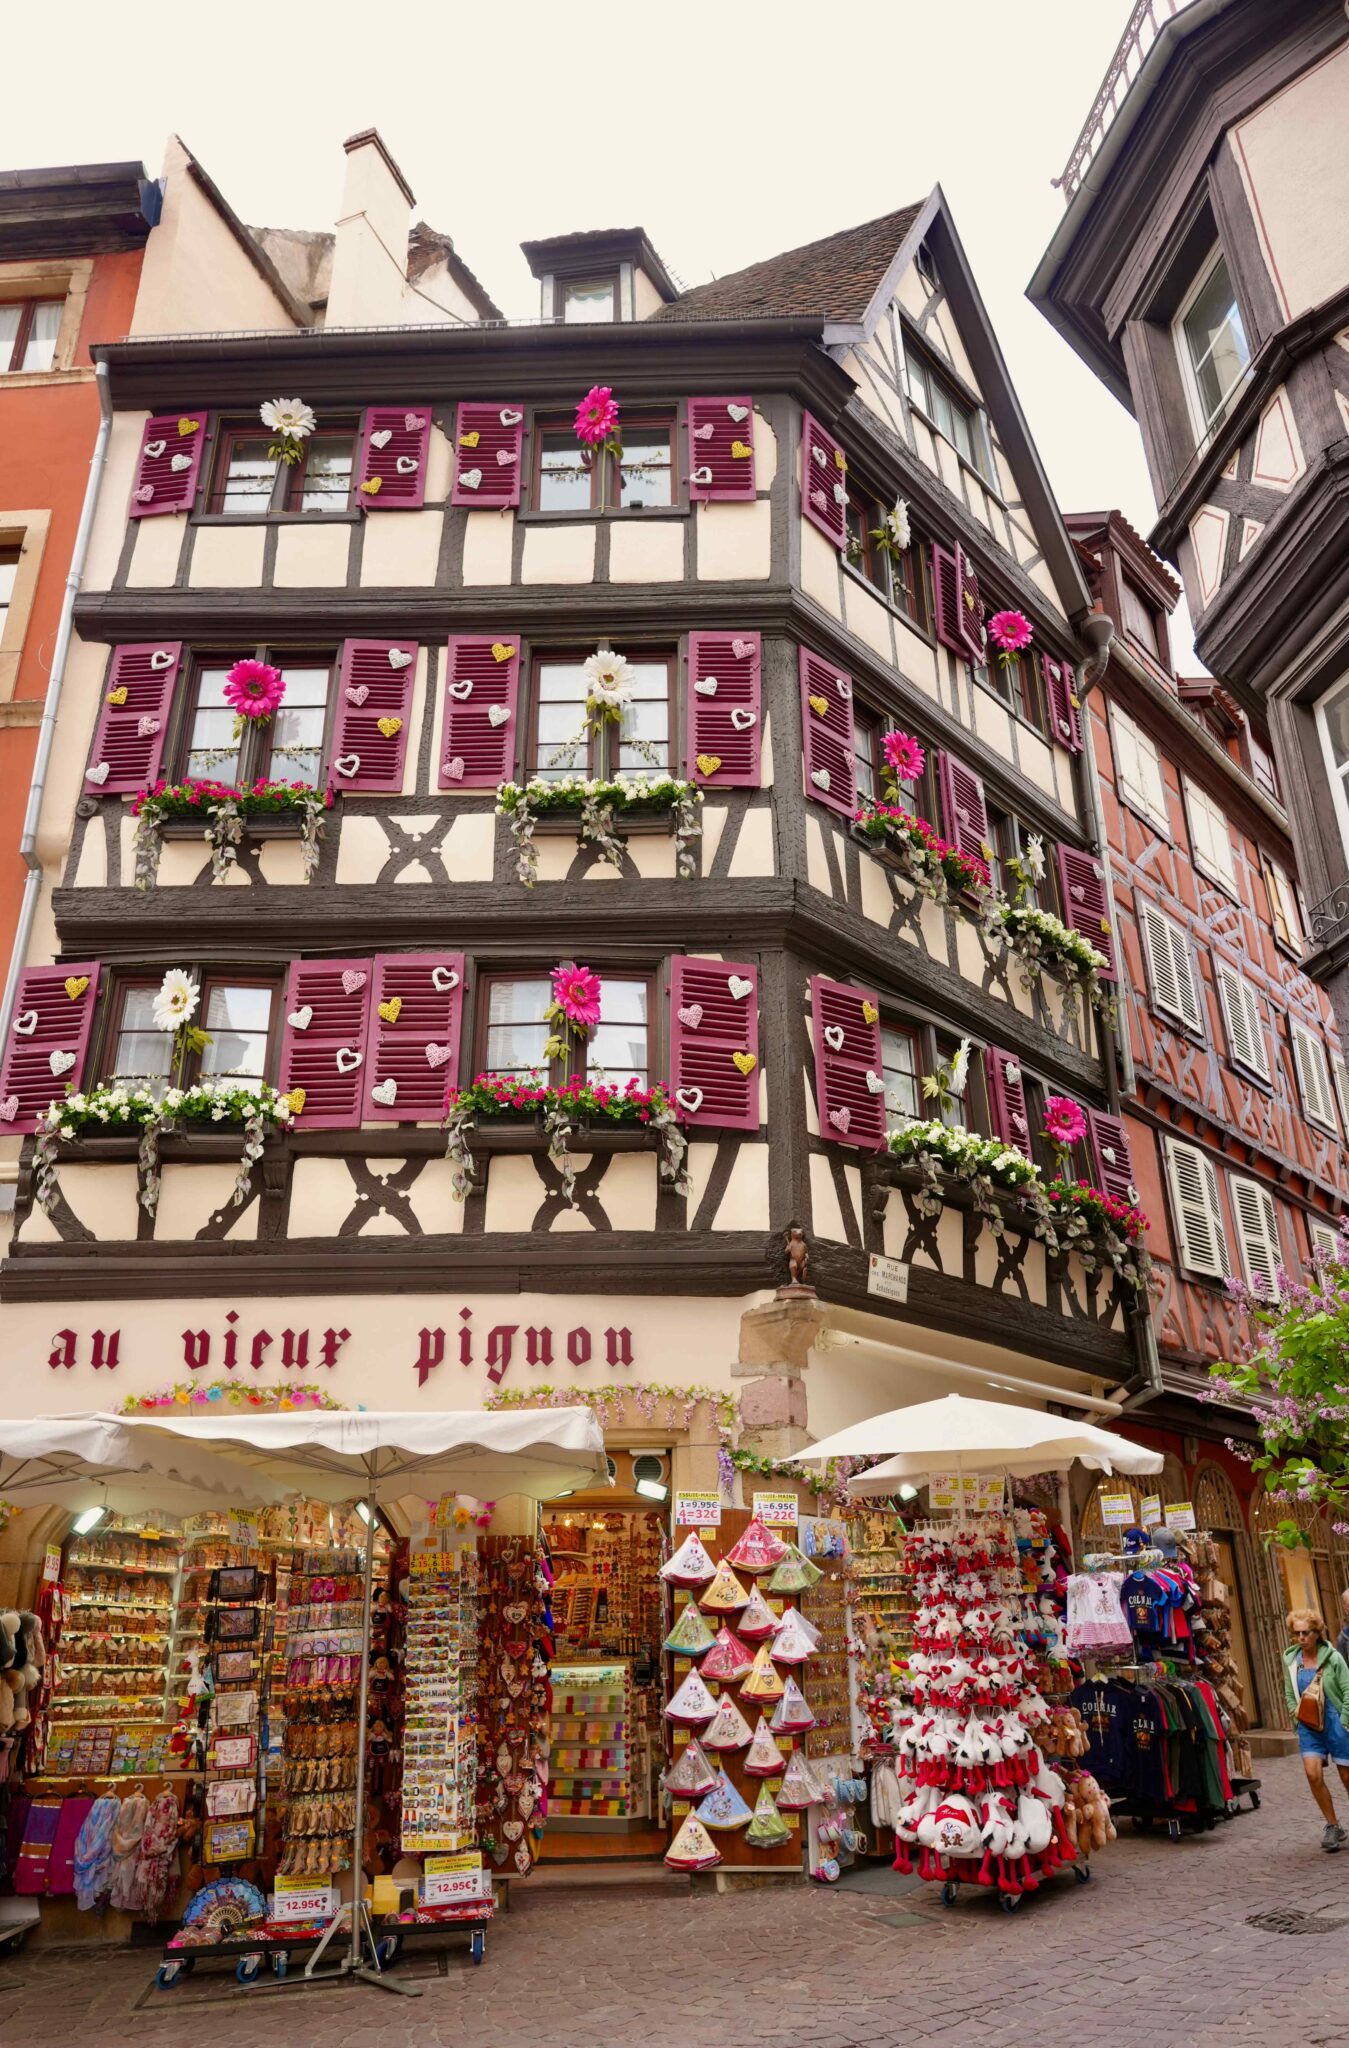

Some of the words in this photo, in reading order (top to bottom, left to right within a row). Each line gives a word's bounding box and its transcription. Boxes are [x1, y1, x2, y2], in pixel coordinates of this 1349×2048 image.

[886, 1263, 899, 1273] RUE
[881, 1270, 907, 1285] MARCHANDS
[48, 1326, 122, 1371] au
[181, 1310, 352, 1371] vieux
[412, 1306, 635, 1388] pignon
[1082, 1701, 1117, 1714] COLMAR
[437, 1881, 472, 1892] 12.95€
[286, 1899, 321, 1910] 12.95€
